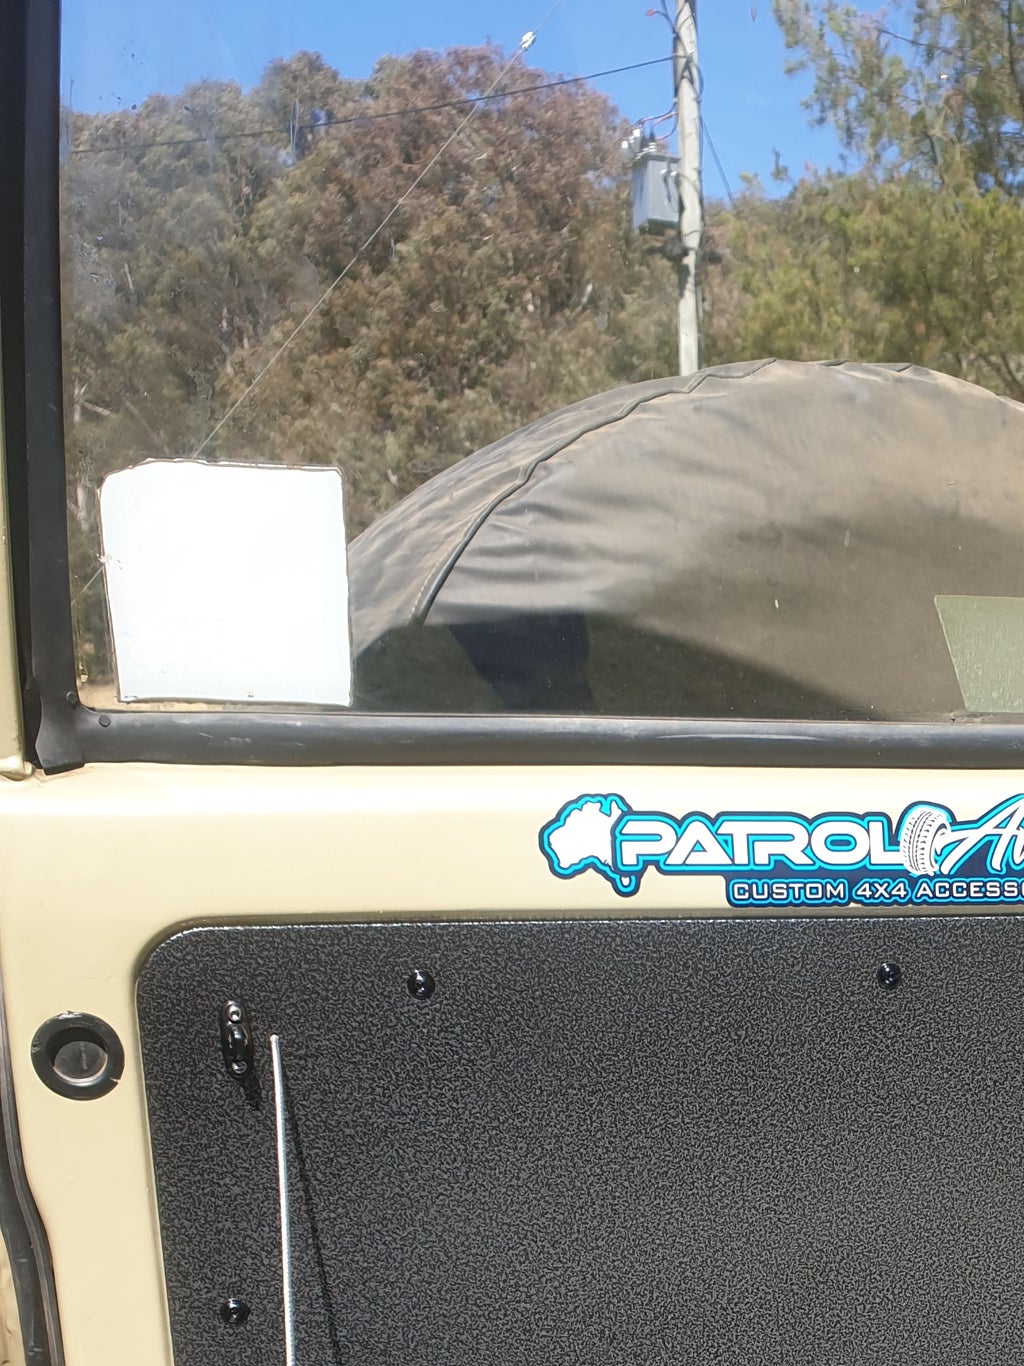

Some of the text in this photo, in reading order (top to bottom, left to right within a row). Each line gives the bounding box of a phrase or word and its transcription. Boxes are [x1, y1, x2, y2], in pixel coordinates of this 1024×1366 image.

[619, 819, 907, 866] PATROL
[732, 882, 846, 900] CUSTOM
[855, 881, 908, 899] 4X4
